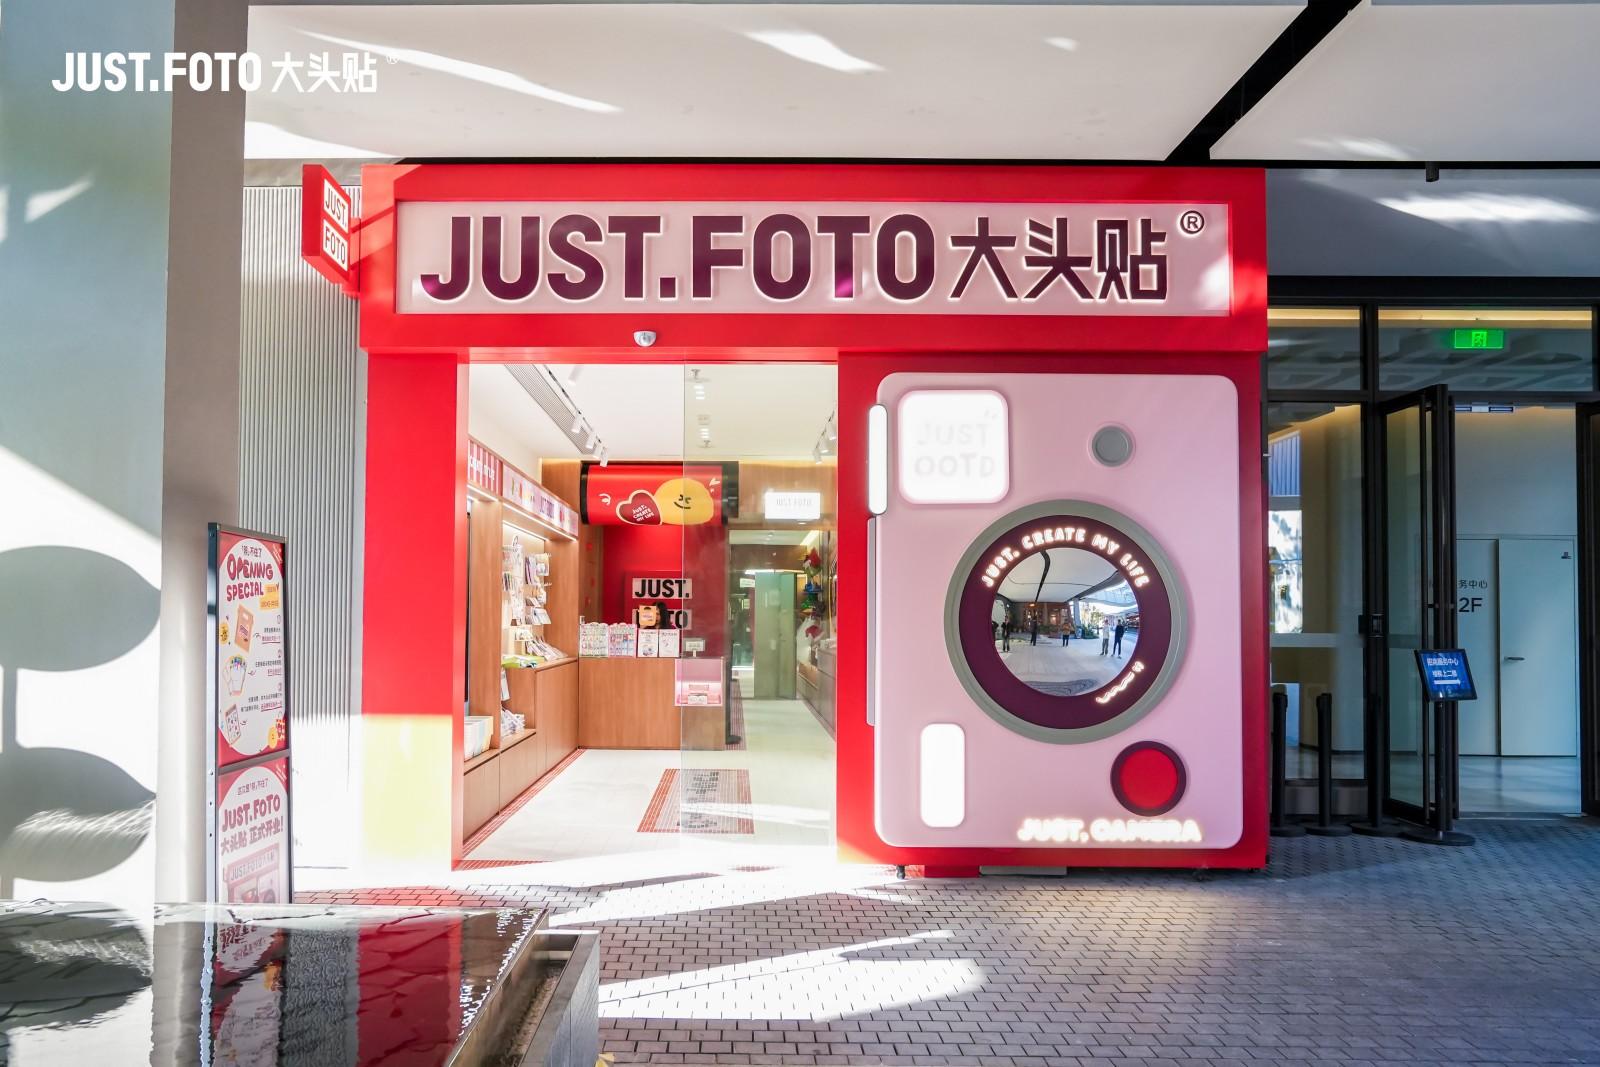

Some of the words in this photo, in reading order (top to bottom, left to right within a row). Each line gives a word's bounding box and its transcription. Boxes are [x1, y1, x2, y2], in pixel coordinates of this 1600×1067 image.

[325, 187, 347, 227] JUST.
[325, 226, 346, 265] FOTO
[420, 213, 936, 301] JUST.FOTO
[948, 216, 1168, 301] 大头贴
[914, 452, 995, 479] OOTD
[227, 553, 274, 581] OPENING
[982, 546, 1021, 588] JUST.
[1021, 527, 1087, 550] CREATE
[1092, 534, 1120, 555] MY
[1119, 553, 1150, 589] LIFE
[226, 582, 264, 602] SPECIAL
[634, 579, 690, 598] JUST.
[1458, 597, 1483, 613] 2F
[222, 794, 280, 833] JUST.FOTO
